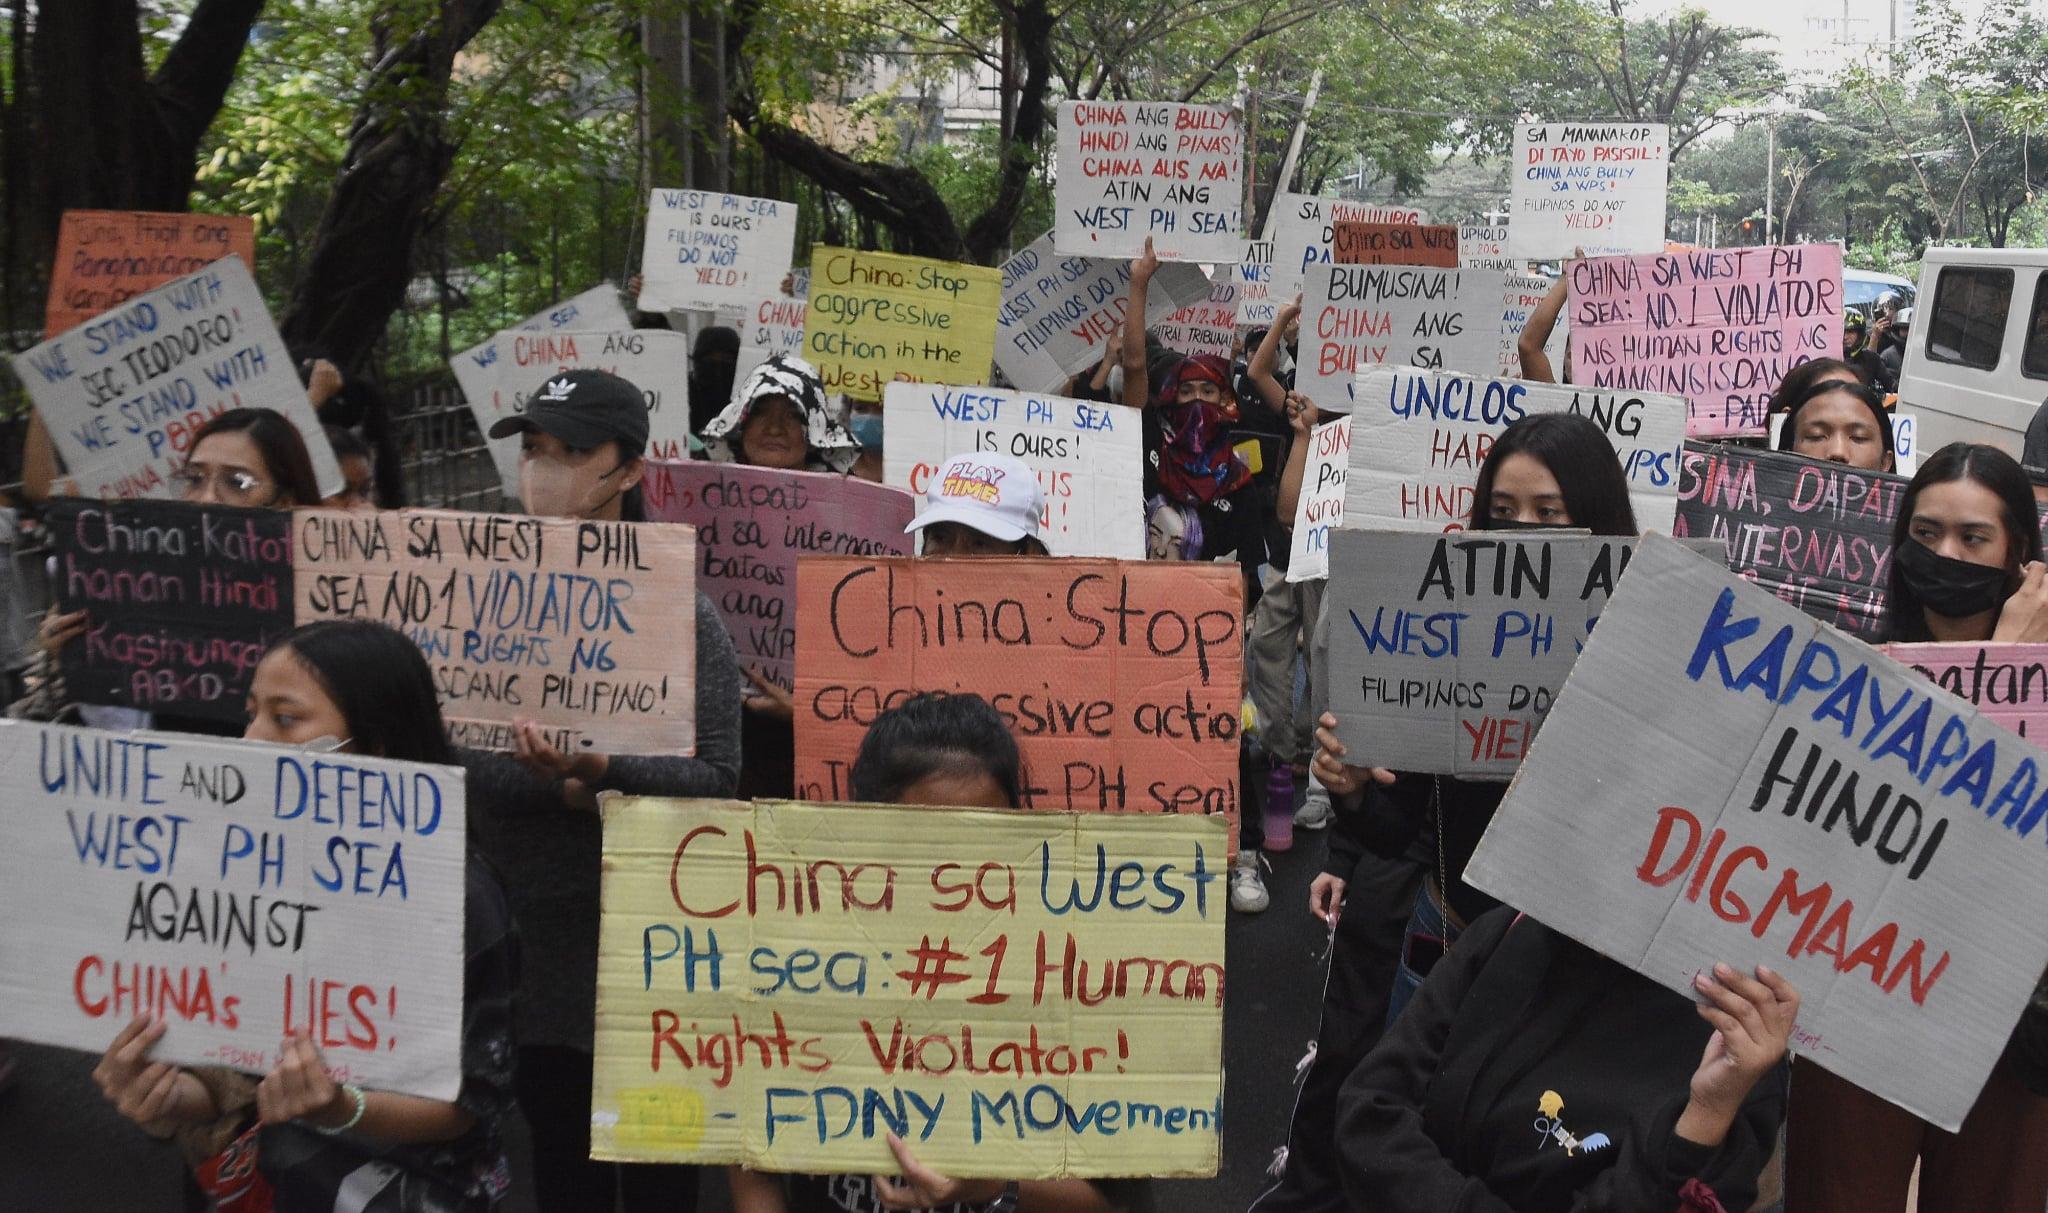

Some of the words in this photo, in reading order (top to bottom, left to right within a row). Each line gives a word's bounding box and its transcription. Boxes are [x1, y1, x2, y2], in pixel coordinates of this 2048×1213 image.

[1074, 104, 1127, 127] CHINA
[1135, 106, 1169, 127] ANG
[1079, 131, 1129, 152] HINDI
[1135, 132, 1167, 151] ANG
[1177, 135, 1239, 155] PINAS!
[1527, 128, 1547, 143] SA
[1083, 158, 1143, 177] CHINA
[1152, 158, 1189, 180] ALIS
[1198, 159, 1237, 182] NA!
[1526, 167, 1562, 180] CHINA
[1566, 167, 1591, 178] ANG
[1597, 167, 1635, 179] BULLY
[1528, 148, 1544, 164] DI
[1552, 147, 1586, 163] TAYO
[662, 191, 708, 210] WEST
[721, 193, 739, 211] PH
[746, 200, 778, 218] SEA
[1103, 180, 1152, 203] ATIN
[1163, 185, 1210, 204] ANG
[1551, 181, 1569, 192] SA
[1575, 181, 1616, 192] WPS!
[690, 212, 702, 225] IS
[1073, 207, 1134, 231] WEST
[1150, 209, 1175, 233] PH
[1188, 210, 1237, 233] SEA!
[1299, 202, 1321, 222] SA
[1524, 199, 1575, 212] FILIPINOS
[1583, 200, 1598, 211] DO
[1602, 200, 1625, 211] NOT
[1564, 214, 1613, 230] YIELD!
[668, 229, 738, 250] FILIPINOS
[1337, 225, 1385, 252] China
[1390, 229, 1412, 250] sa
[1421, 227, 1457, 250] WPS
[1461, 227, 1507, 241] UPHOLD
[678, 248, 700, 263] DO
[708, 250, 737, 266] NOT
[1573, 261, 1643, 297] CHINA
[1651, 256, 1682, 288] SA
[1690, 250, 1753, 280] WEST
[1768, 249, 1802, 279] PH
[826, 255, 912, 287] China:
[916, 267, 968, 298] Stop
[997, 289, 1036, 327] WEST
[1037, 275, 1062, 298] PH
[1060, 257, 1092, 282] SEA
[1328, 267, 1460, 304] BUMUSINA!
[814, 293, 950, 329] aggressive
[1013, 294, 1088, 355] FILIPINOS
[1087, 277, 1114, 304] DO
[1245, 304, 1275, 320] WPS
[1502, 311, 1525, 322] ANG
[1578, 301, 1632, 326] SEA:
[1715, 279, 1835, 326] VIOLATOR
[30, 344, 76, 383] WE
[85, 302, 158, 354] STAND
[167, 273, 223, 311] WITH
[756, 327, 771, 345] SA
[1317, 306, 1393, 338] CHINA
[1412, 312, 1464, 338] ANG
[122, 307, 243, 384] TEODORO!
[515, 336, 578, 366] CHINA
[603, 334, 645, 355] ANG
[811, 331, 887, 359] action
[896, 340, 915, 358] in
[921, 340, 960, 363] the
[1411, 346, 1443, 370] SA
[1583, 338, 1615, 364] NG
[1622, 328, 1701, 360] HUMAN
[1711, 322, 1782, 355] RIGHTS
[1796, 325, 1827, 351] NG
[819, 363, 883, 392] West
[72, 415, 116, 452] WE
[120, 378, 196, 433] STAND
[204, 345, 268, 390] WITH
[932, 392, 1005, 422] WEST
[1026, 400, 1053, 425] PH
[1073, 405, 1113, 432] SEA
[1390, 375, 1528, 427] UNCLOS
[975, 429, 999, 453] IS
[1010, 432, 1080, 460] OURS!
[949, 462, 1005, 485] PLAY
[1678, 451, 1773, 516] SINA,
[1788, 465, 1907, 523] DAPAT
[702, 474, 808, 515] dapat
[302, 516, 391, 563] CHINA
[407, 518, 442, 563] SA
[457, 516, 543, 568] WEST
[576, 523, 652, 572] PHIL
[732, 521, 769, 548] sa
[703, 548, 786, 585] batas
[1417, 539, 1552, 600] ATIN
[200, 568, 278, 611] Hindi
[309, 575, 369, 616] SEA
[468, 569, 634, 635] VIOLATOR
[722, 591, 783, 631] ang
[829, 566, 1053, 658] China:
[1061, 573, 1235, 687] Stop
[464, 629, 552, 666] RIGHTS
[1349, 607, 1470, 658] WEST
[1492, 612, 1553, 658] PH
[541, 674, 668, 715] PILIPINO!
[1362, 677, 1486, 710] FILIPINOS
[1508, 684, 1557, 713] DO
[40, 731, 168, 805] UNITE
[180, 762, 246, 806] AND
[274, 756, 442, 836] DEFEND
[1064, 762, 1126, 810] PH
[1750, 727, 1950, 880] HINDI
[66, 808, 192, 876] WEST
[220, 824, 285, 889] PH
[311, 834, 409, 900] SEA
[670, 824, 897, 919] China
[931, 863, 1016, 915] sa
[1042, 840, 1216, 919] West
[125, 881, 323, 955] AGAINST
[1635, 806, 1950, 1007] DIGMAAN
[643, 924, 724, 994] PH
[752, 949, 892, 996] sea:
[897, 932, 1012, 1004] #1
[1033, 931, 1225, 1008] Human
[283, 972, 398, 1053] LIES!
[651, 1009, 831, 1086] Rights
